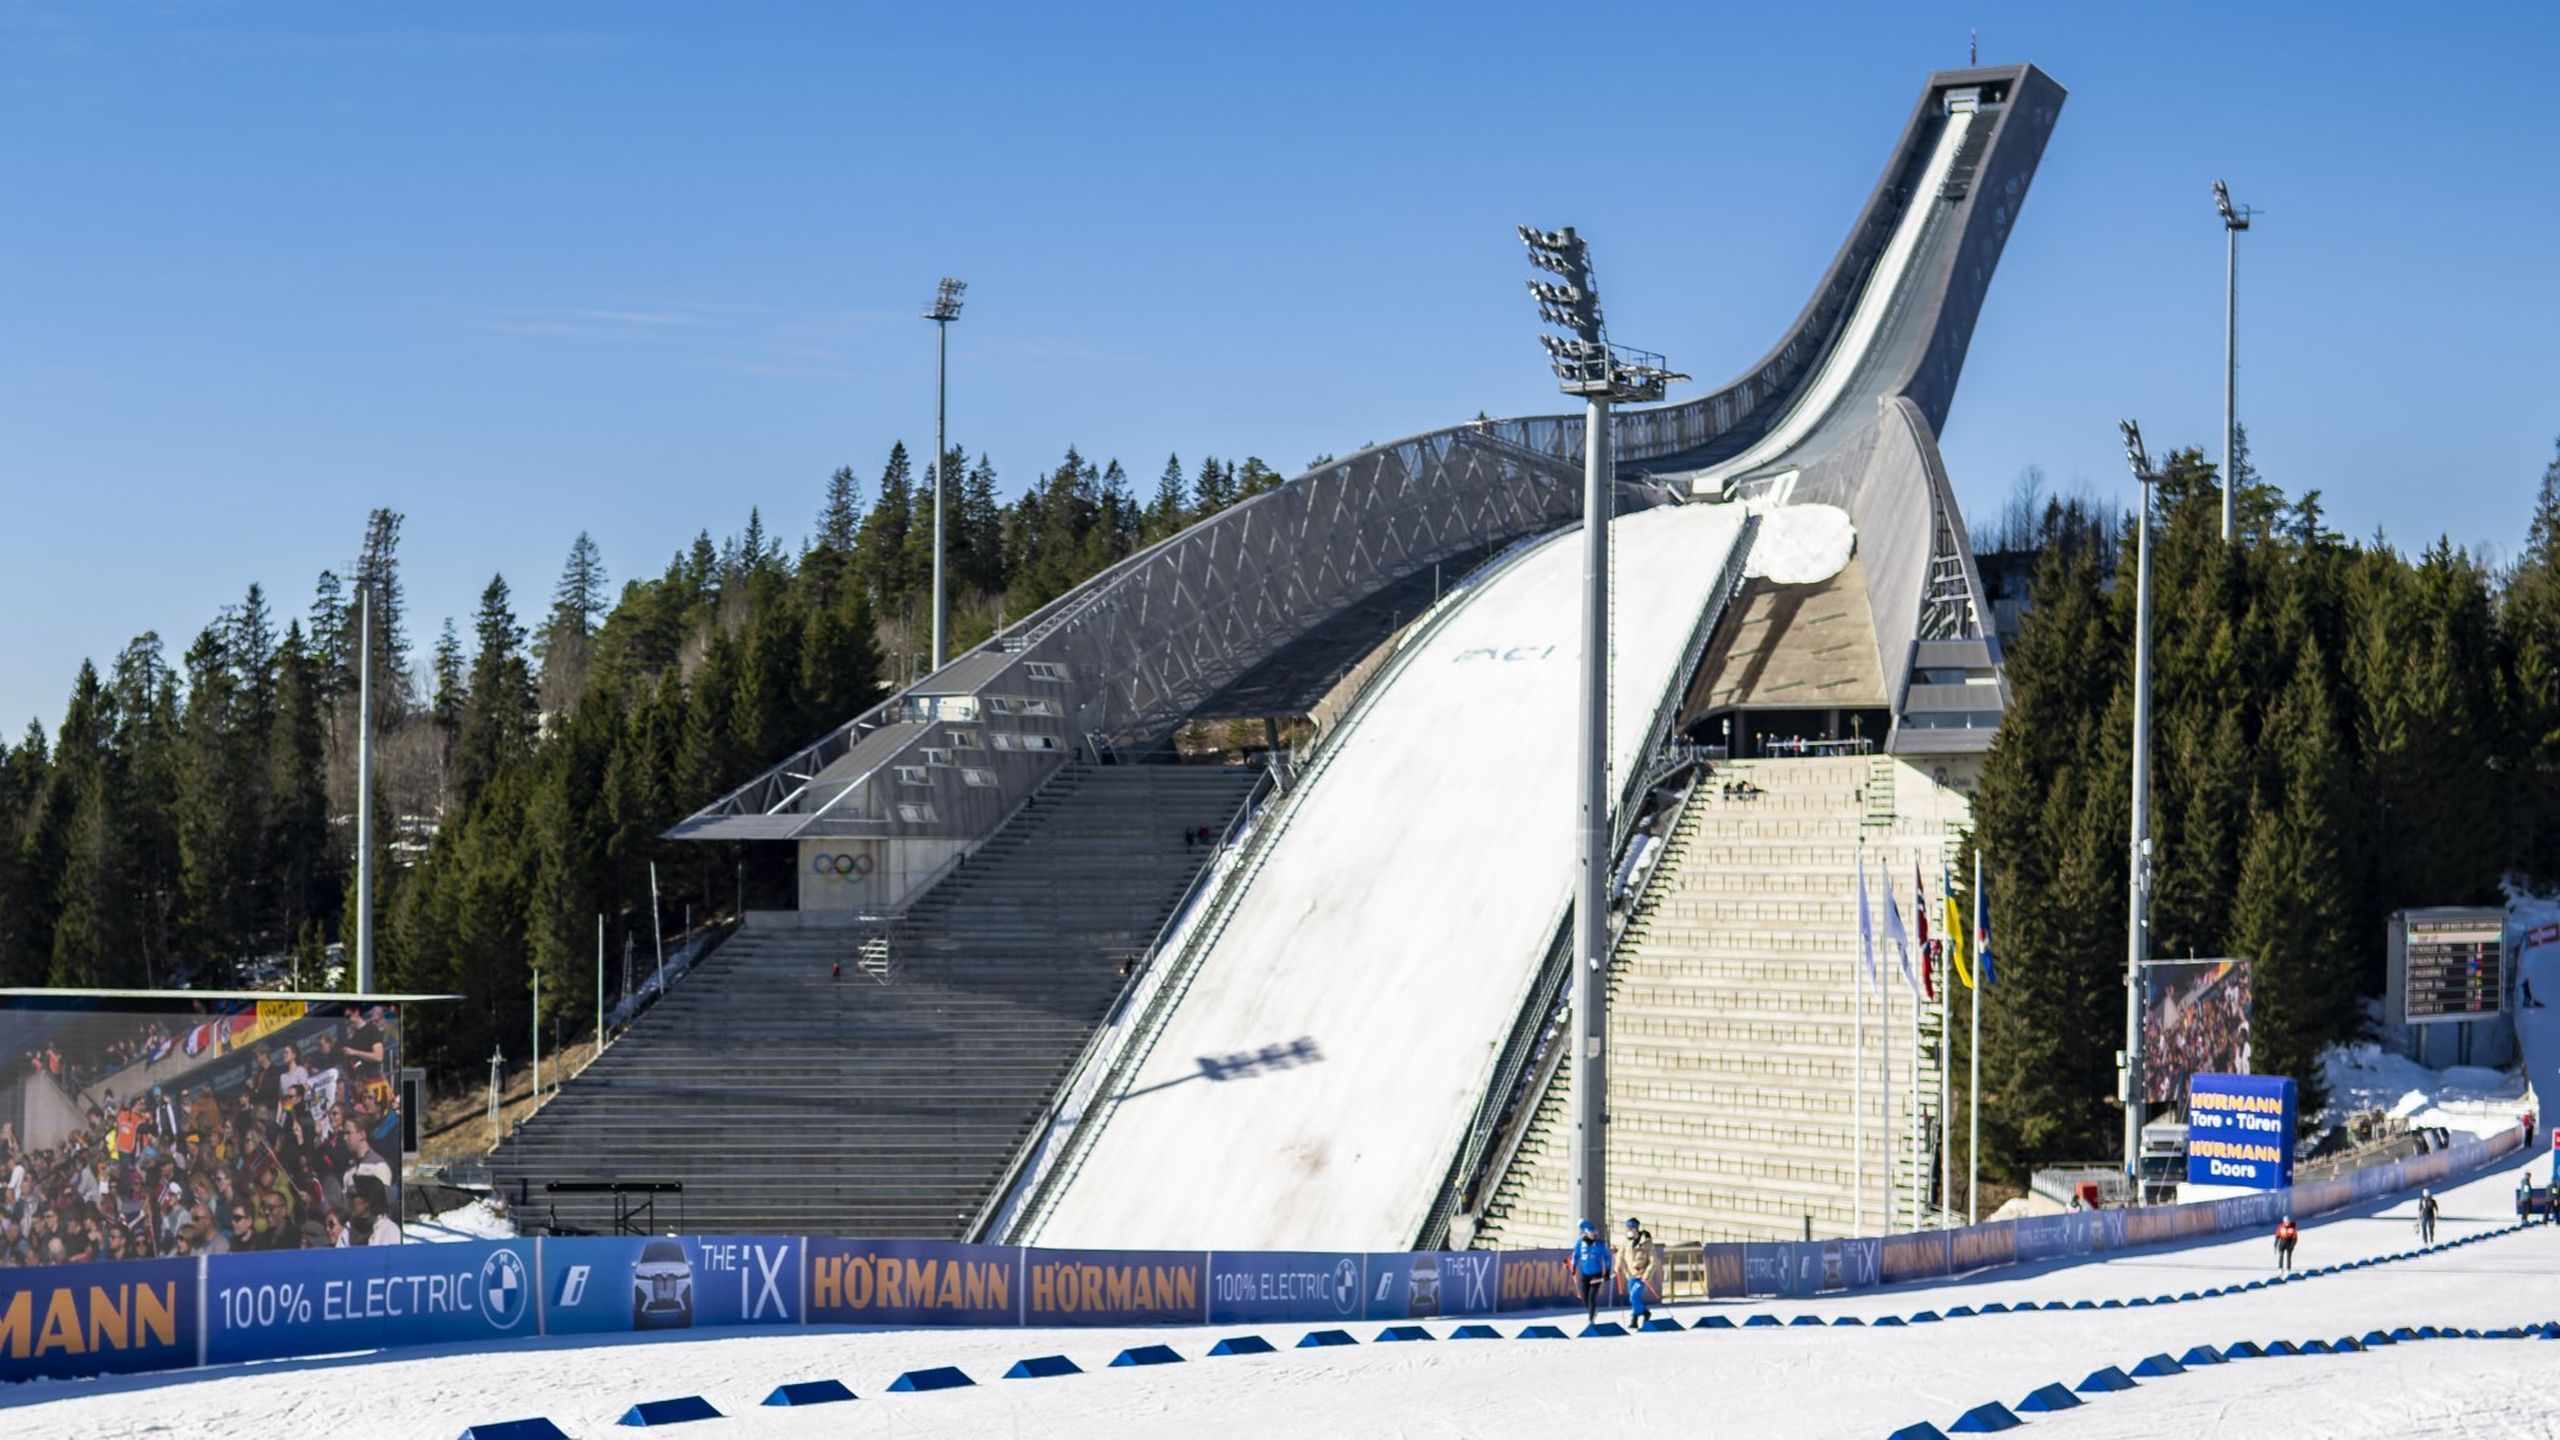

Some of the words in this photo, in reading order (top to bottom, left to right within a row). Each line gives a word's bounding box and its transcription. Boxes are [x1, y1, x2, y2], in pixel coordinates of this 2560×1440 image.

[2190, 1093, 2282, 1115] HÖRMANN
[2191, 1111, 2222, 1128] Tore
[2236, 1113, 2281, 1132] Türen
[2190, 1141, 2280, 1163] HÖRMANN
[2210, 1160, 2256, 1178] Doors
[702, 1245, 736, 1271] THE
[1446, 1257, 1464, 1275] THE
[742, 1245, 788, 1318] iX
[814, 1252, 1009, 1310] HÖRMANN
[1032, 1260, 1196, 1312] HÖRMANN
[1215, 1273, 1256, 1301] 100%
[1261, 1273, 1330, 1300] ELECTRIC
[220, 1284, 311, 1329] 100%
[324, 1272, 473, 1320] ELECTRIC
